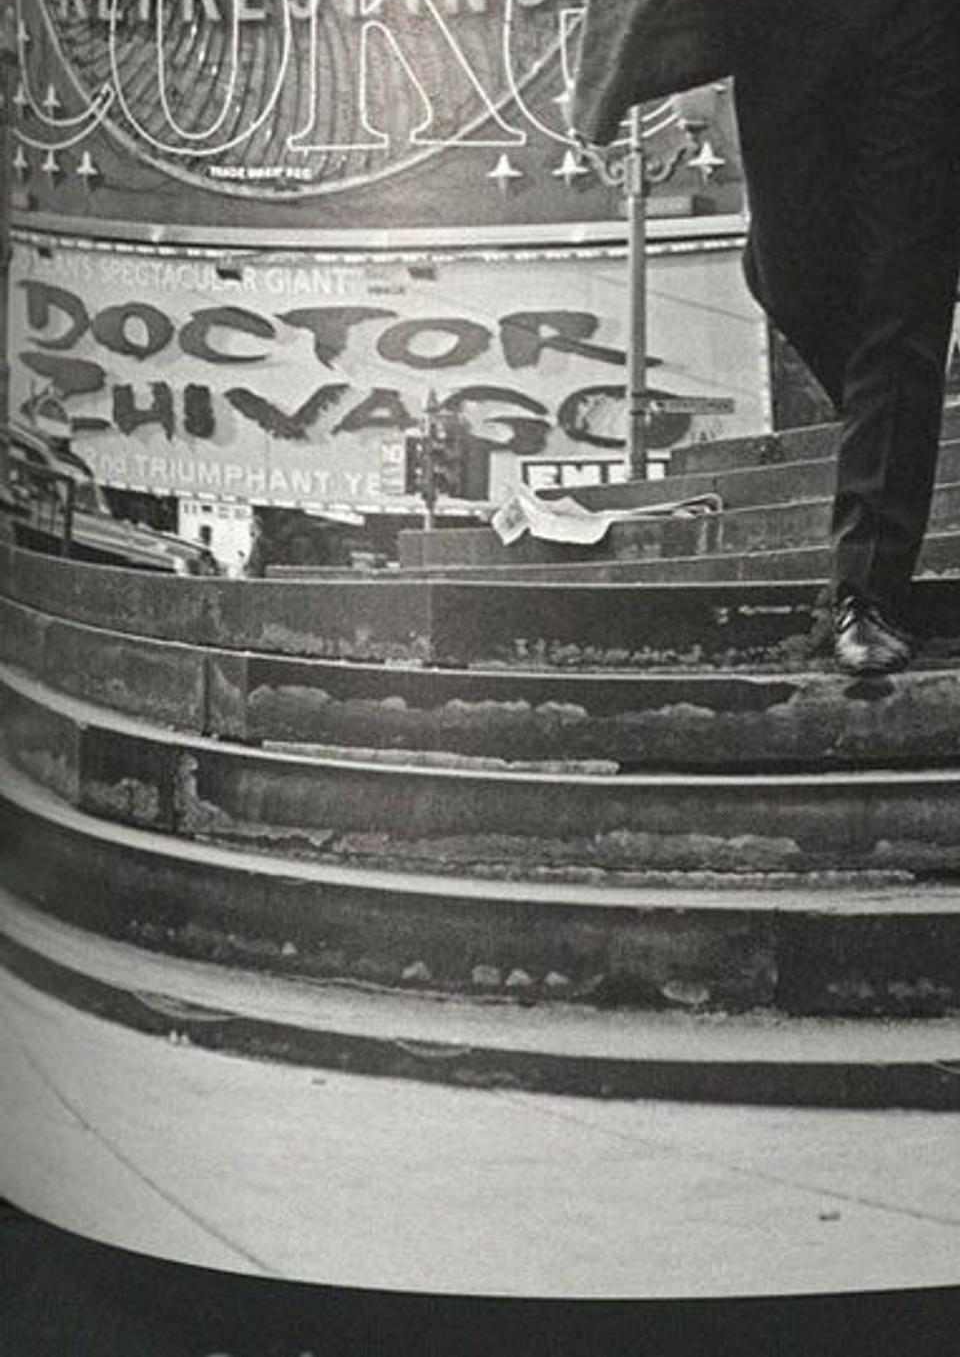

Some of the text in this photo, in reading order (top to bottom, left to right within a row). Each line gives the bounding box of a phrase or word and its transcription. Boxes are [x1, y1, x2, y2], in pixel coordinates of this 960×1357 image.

[263, 266, 347, 295] GIANT
[19, 280, 662, 370] DOCTOR
[19, 351, 692, 455] ZHIVAGO
[134, 454, 331, 495] TRIUMPHANT
